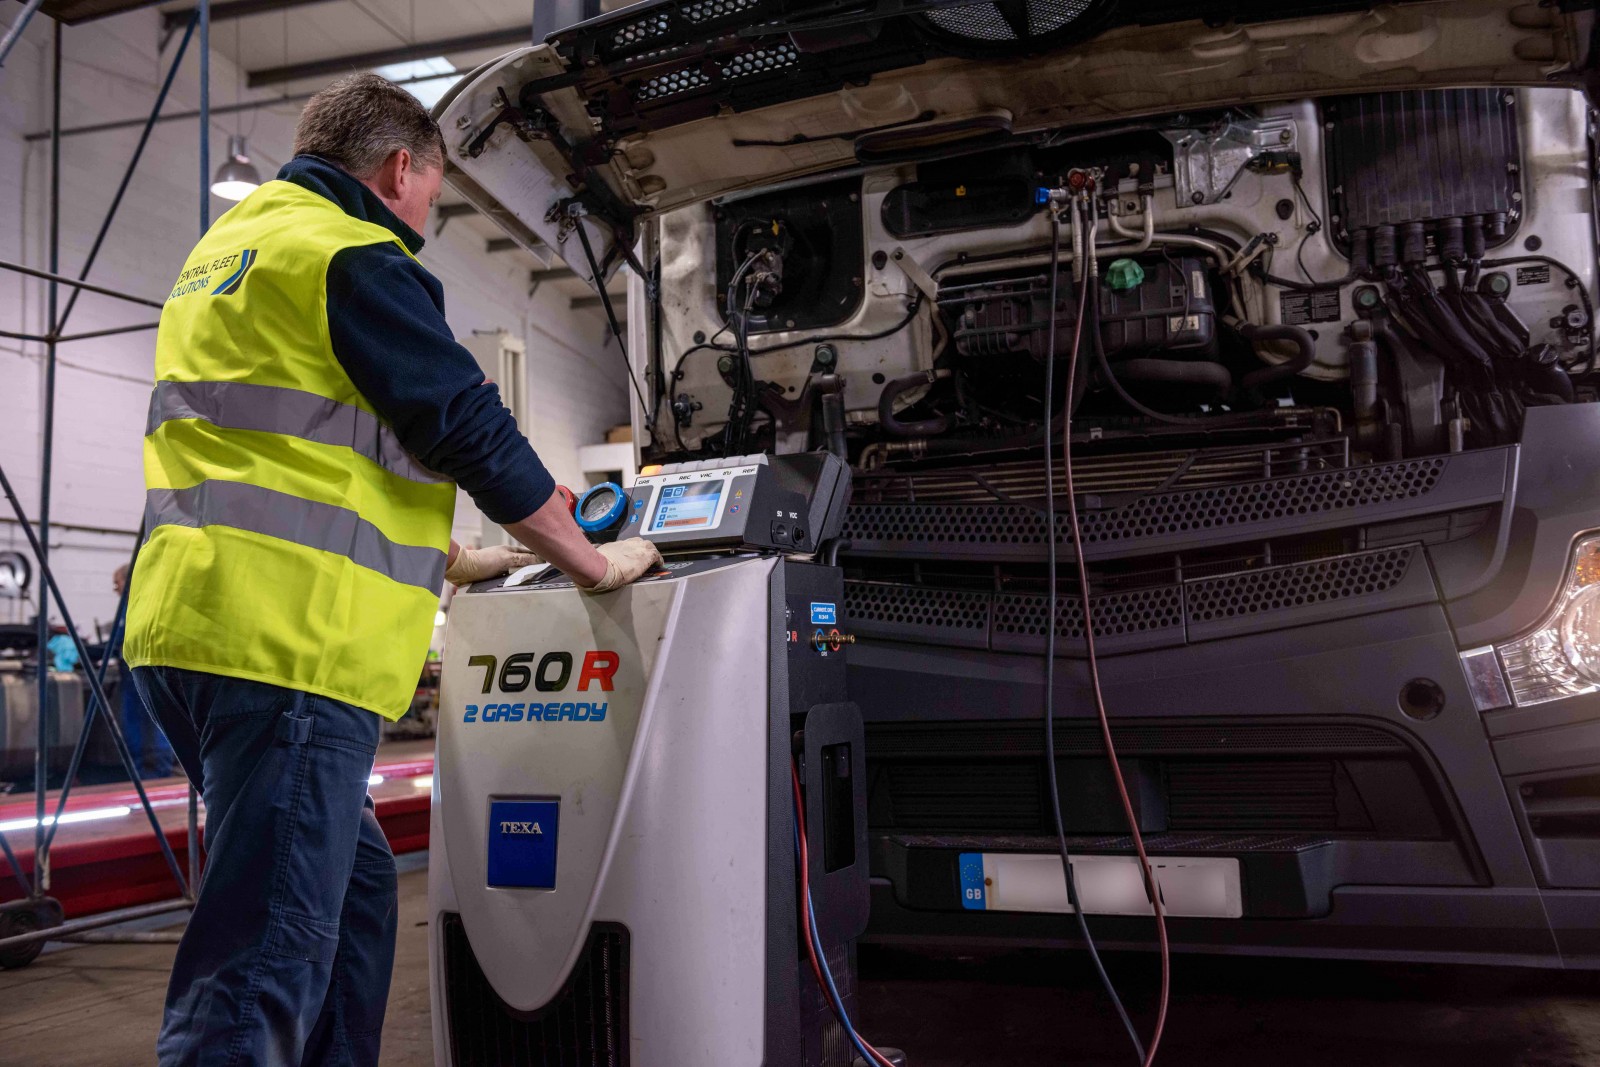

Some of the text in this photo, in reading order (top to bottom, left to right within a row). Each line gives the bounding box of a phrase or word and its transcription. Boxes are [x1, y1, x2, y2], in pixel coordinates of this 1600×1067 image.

[209, 254, 239, 273] FLEET
[463, 702, 608, 723] 2 GAS READY
[499, 821, 543, 835] TEXA
[965, 888, 982, 900] GB
